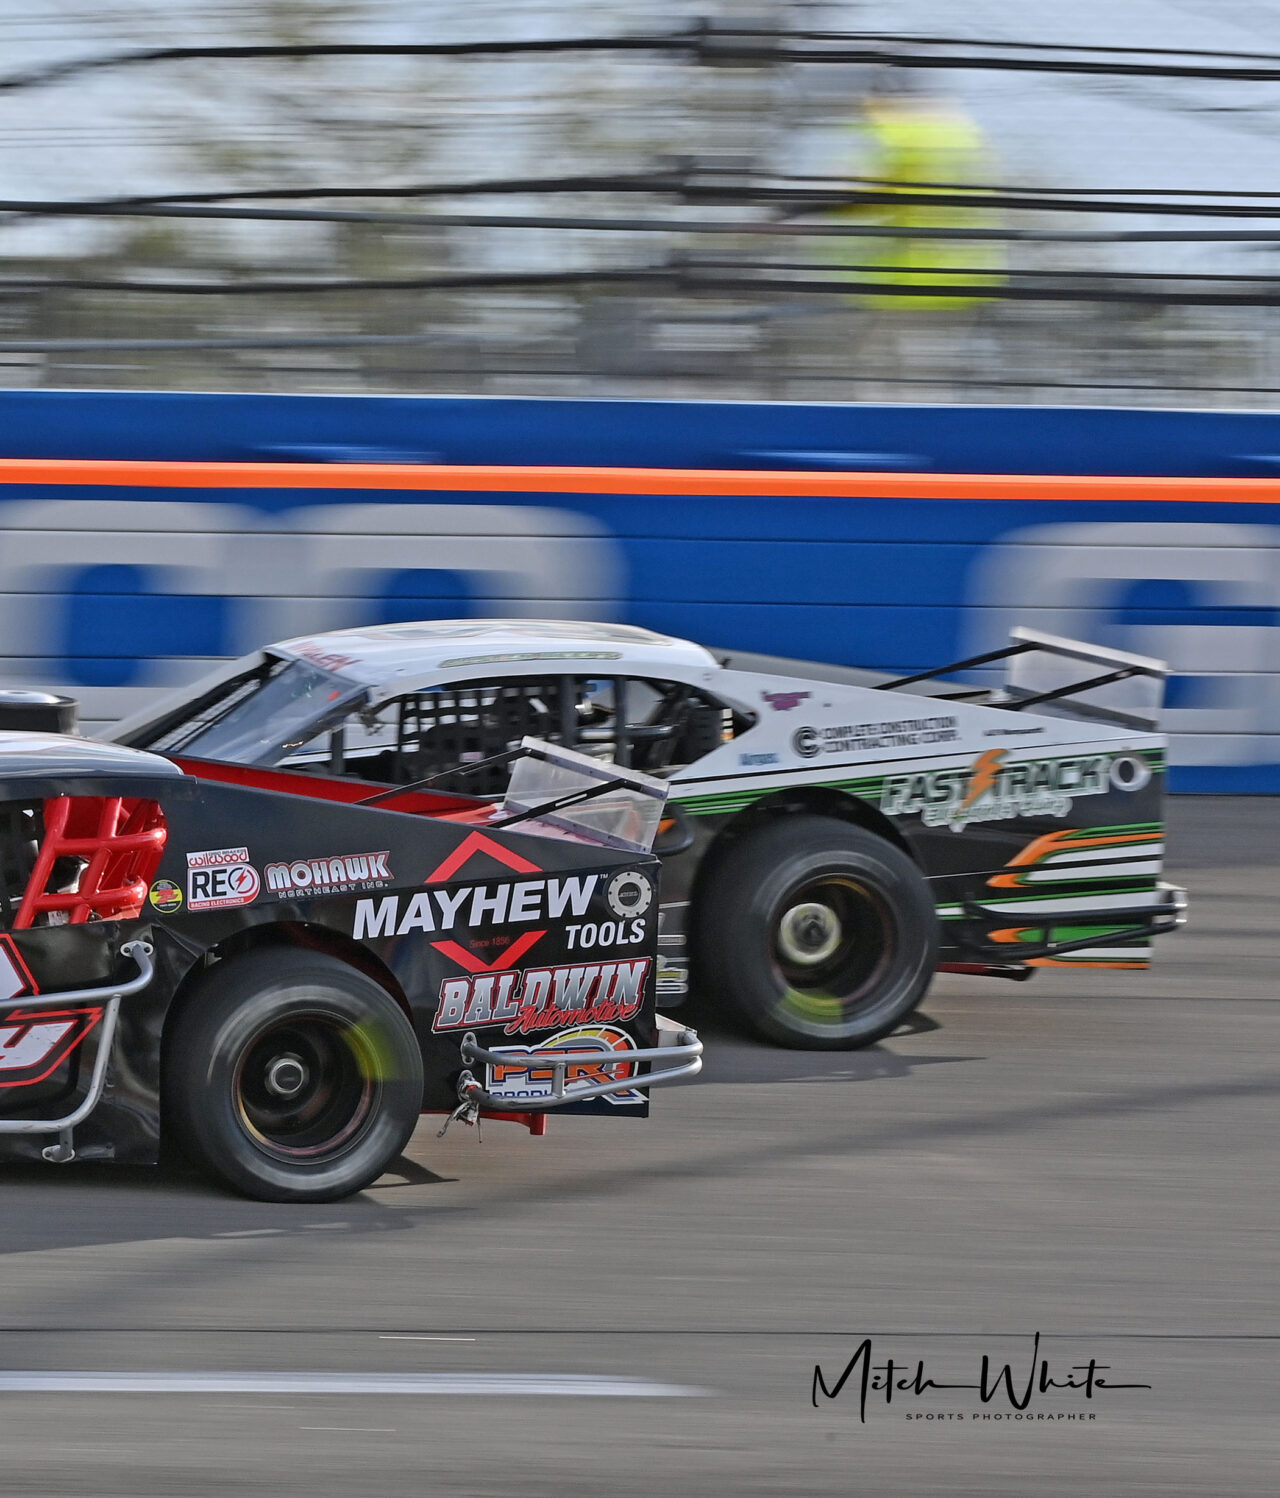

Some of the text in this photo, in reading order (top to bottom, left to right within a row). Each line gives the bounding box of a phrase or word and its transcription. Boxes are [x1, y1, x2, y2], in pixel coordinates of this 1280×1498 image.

[268, 854, 389, 891] MOHAWK
[278, 881, 390, 899] NORTHEAST INC.
[352, 874, 598, 941] MAYHEW
[565, 918, 647, 950] TOOLS
[436, 961, 648, 1027] BALDWIN
[504, 1000, 638, 1034] Automotive
